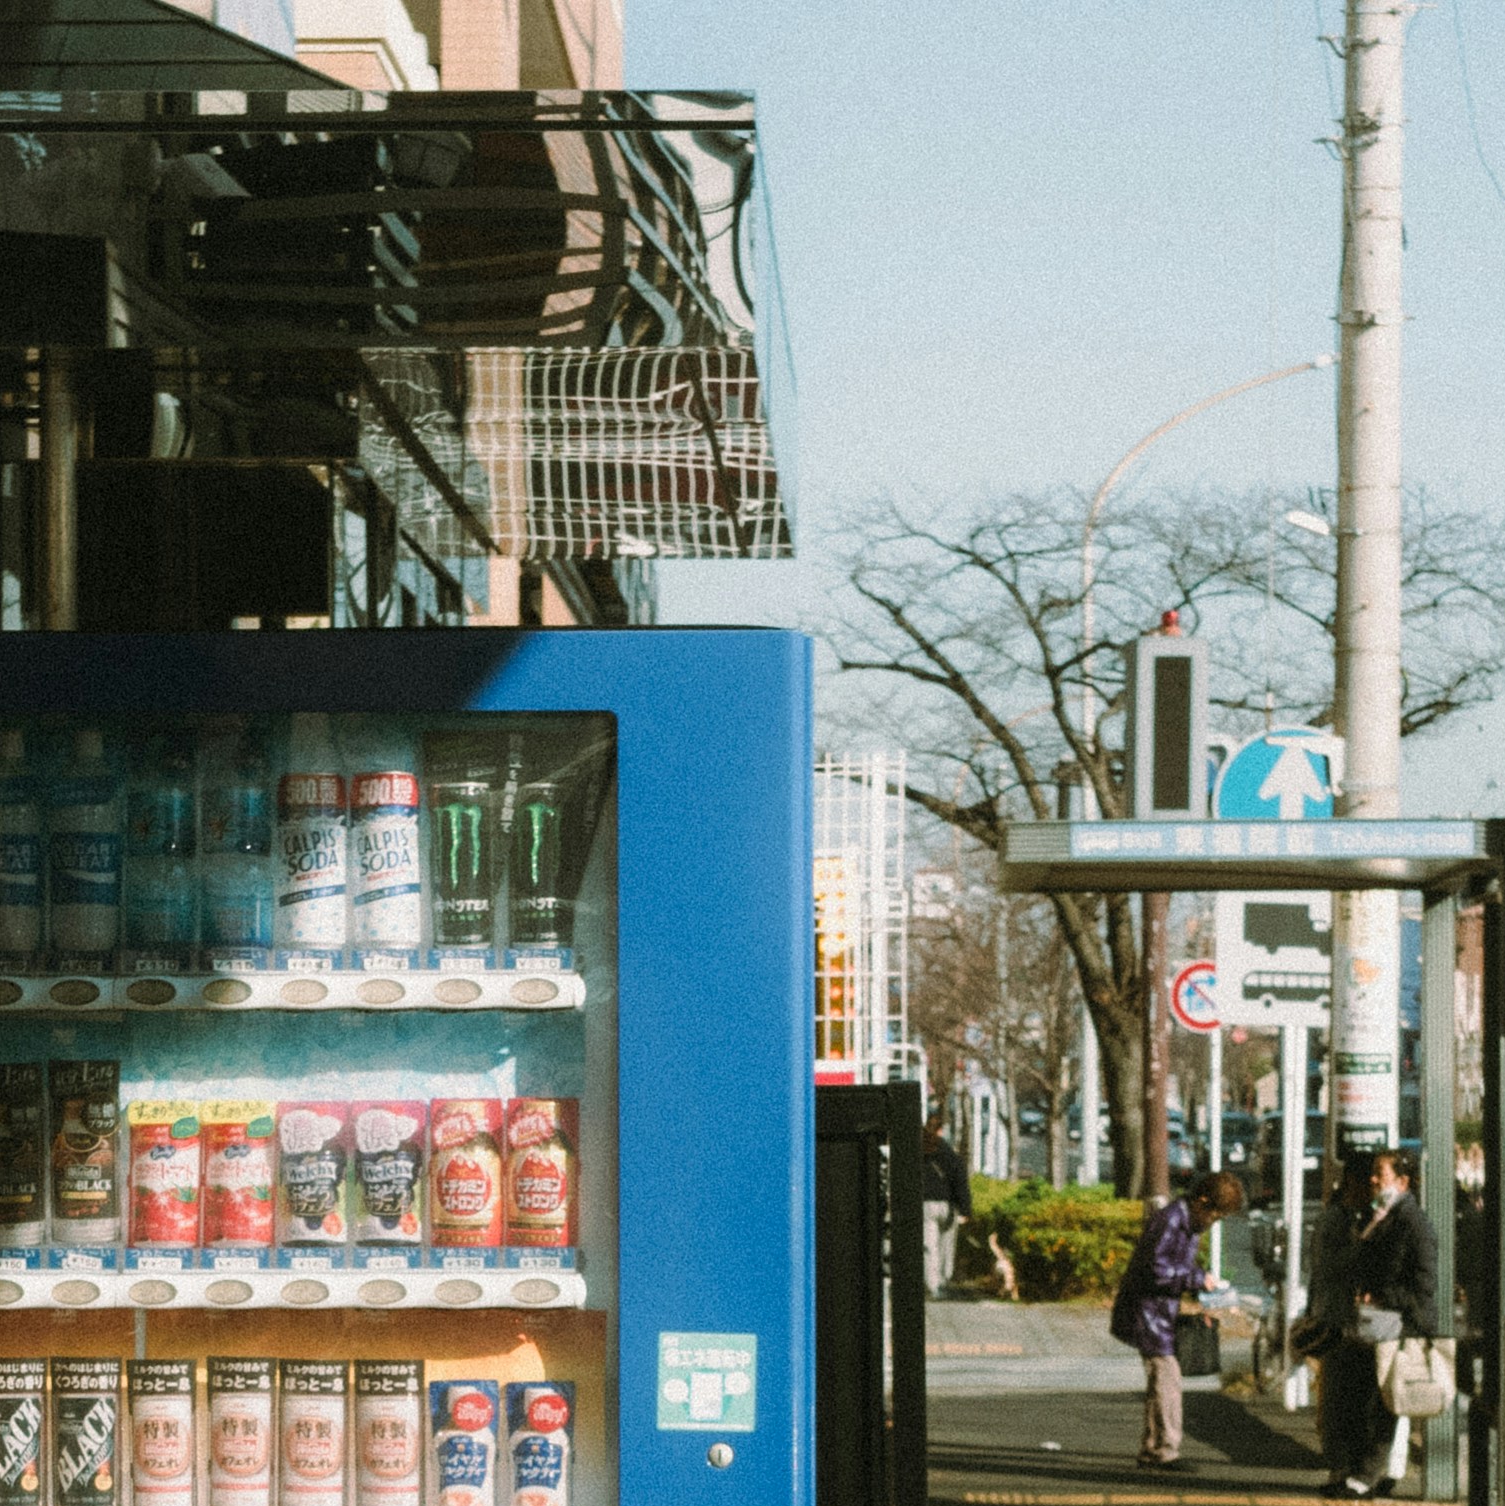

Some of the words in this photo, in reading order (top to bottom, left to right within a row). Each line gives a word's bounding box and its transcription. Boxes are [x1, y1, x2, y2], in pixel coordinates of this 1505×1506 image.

[285, 828, 337, 855] CALPIS
[358, 828, 410, 855] CALPIS
[288, 850, 339, 876] SODA
[361, 849, 412, 876] SODA
[56, 1376, 119, 1390] くつろぎの香り
[132, 1377, 191, 1391] ほっと一息
[212, 1375, 271, 1389] ほっと一息
[285, 1378, 344, 1392] ほっと一息
[360, 1378, 419, 1392] ほっと一息
[144, 1420, 180, 1439] 特製
[222, 1418, 258, 1437] 特製
[296, 1420, 333, 1439] 特製
[371, 1420, 407, 1440] 特製
[60, 1400, 116, 1494] BLACK
